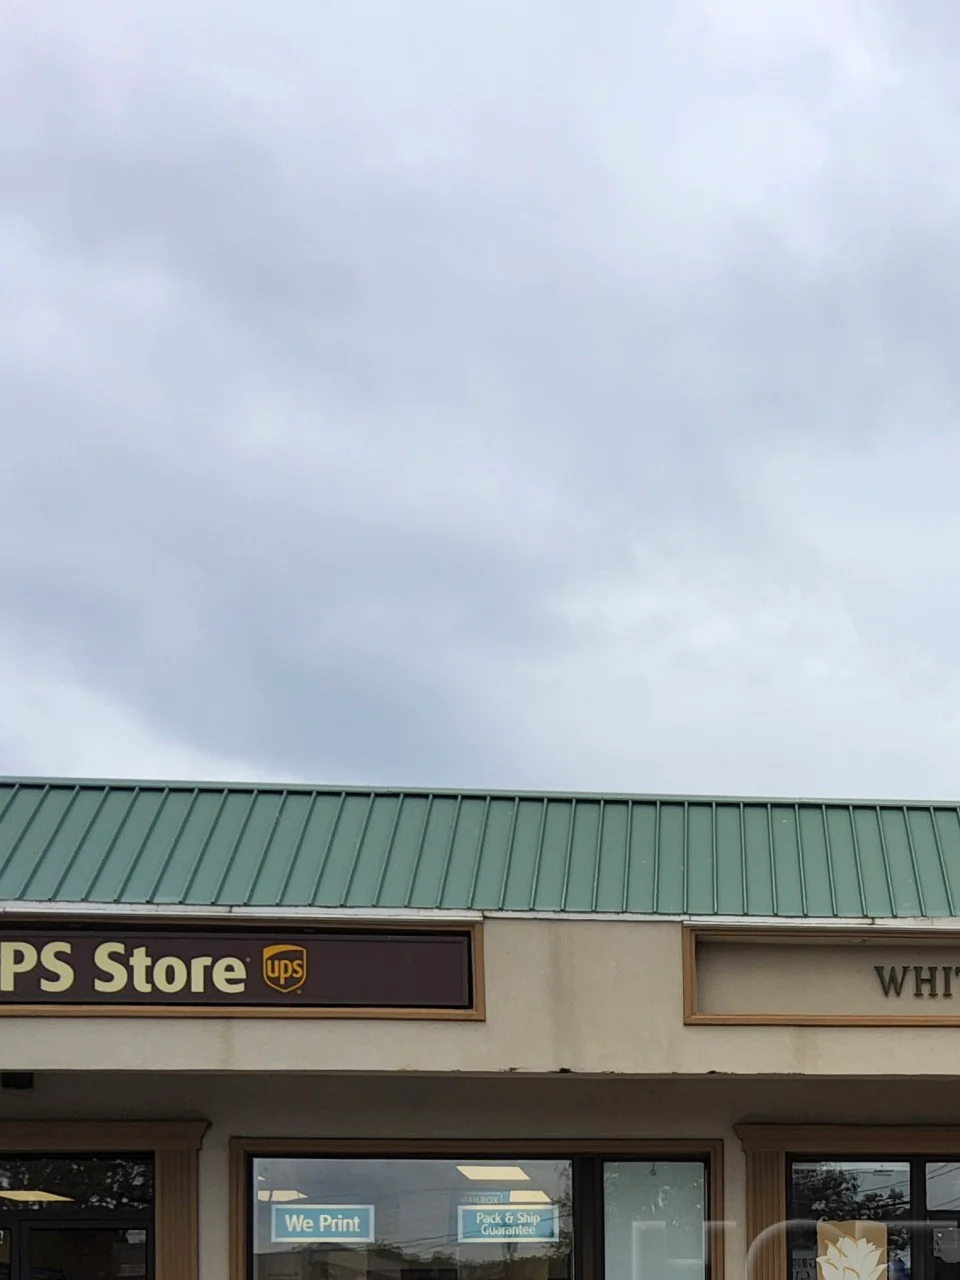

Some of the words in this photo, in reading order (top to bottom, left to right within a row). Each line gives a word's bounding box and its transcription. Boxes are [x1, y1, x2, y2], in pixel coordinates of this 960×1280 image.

[94, 941, 247, 993] Store
[266, 957, 304, 985] ups
[285, 1214, 314, 1232] We
[319, 1214, 361, 1232] Print
[476, 1212, 502, 1224] Pack
[505, 1212, 513, 1224] &
[517, 1212, 541, 1225] Ship
[481, 1224, 536, 1235] Guarantee
